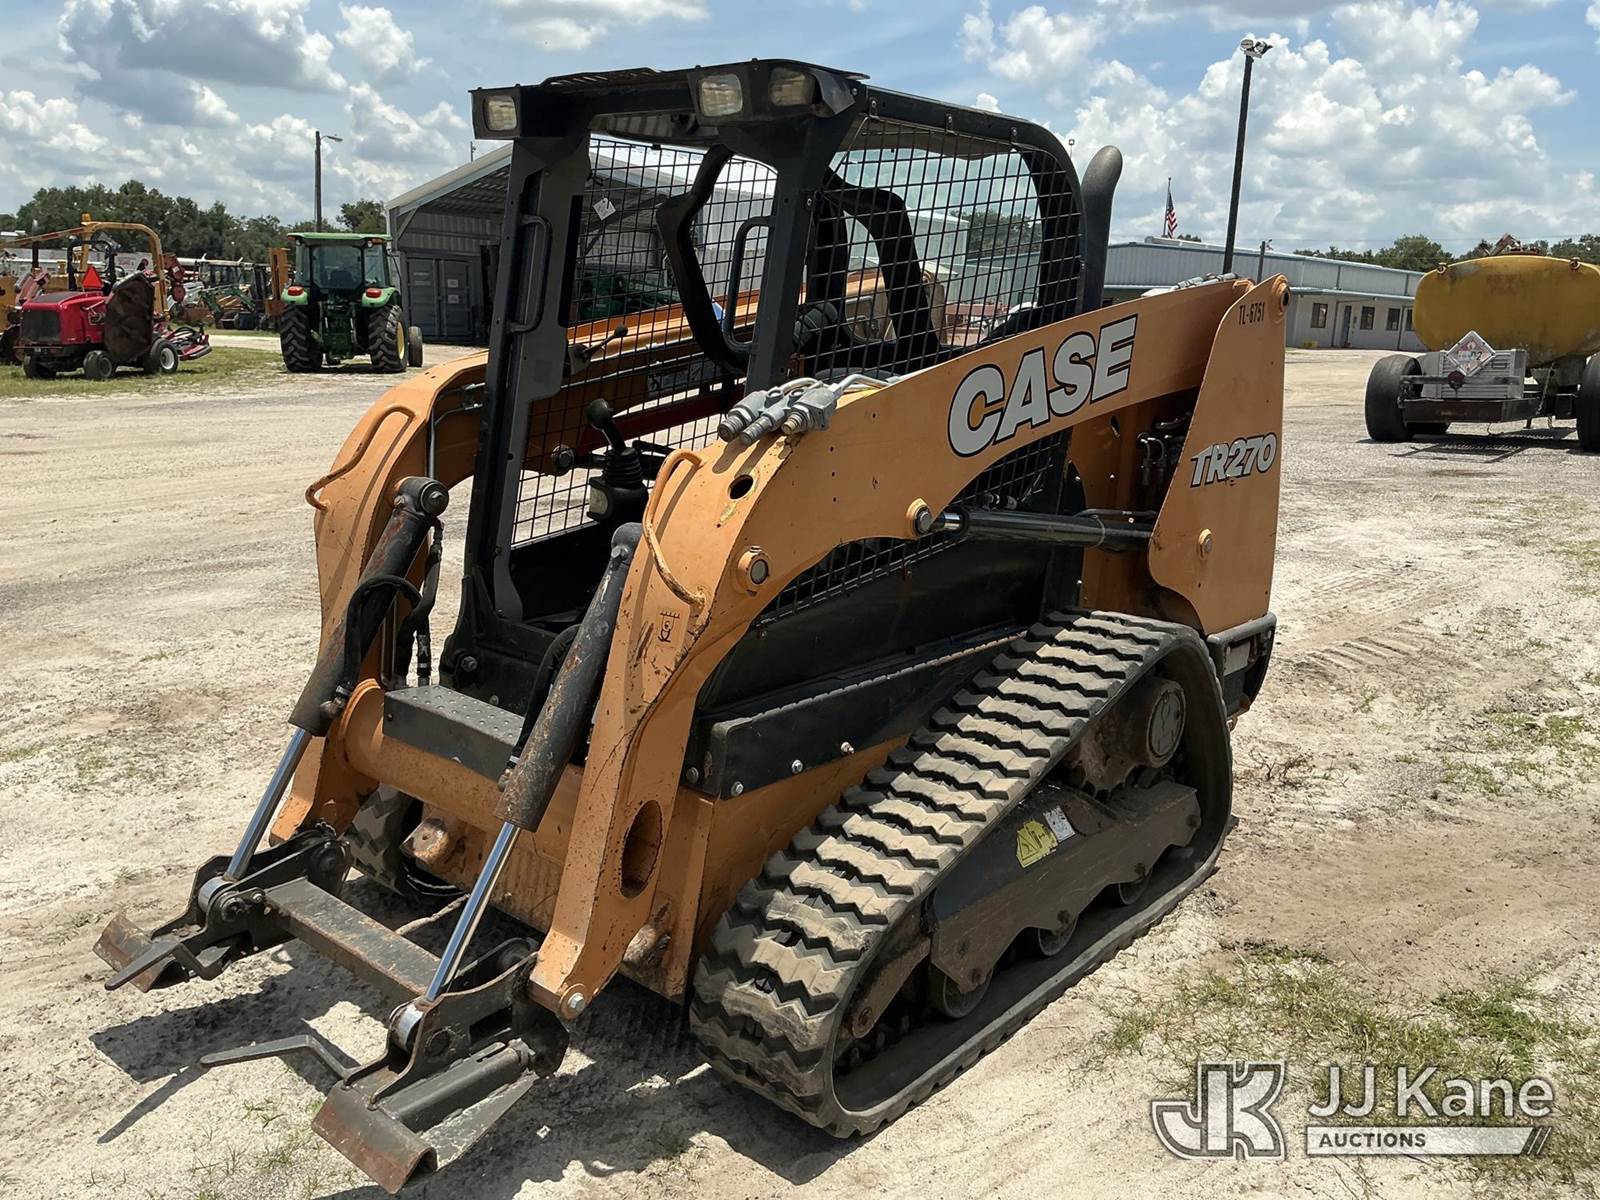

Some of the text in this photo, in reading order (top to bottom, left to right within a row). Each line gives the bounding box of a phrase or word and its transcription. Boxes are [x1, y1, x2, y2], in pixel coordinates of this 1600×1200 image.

[1239, 302, 1266, 325] TL-6751
[948, 315, 1138, 456] CASE
[1191, 433, 1279, 487] TR270
